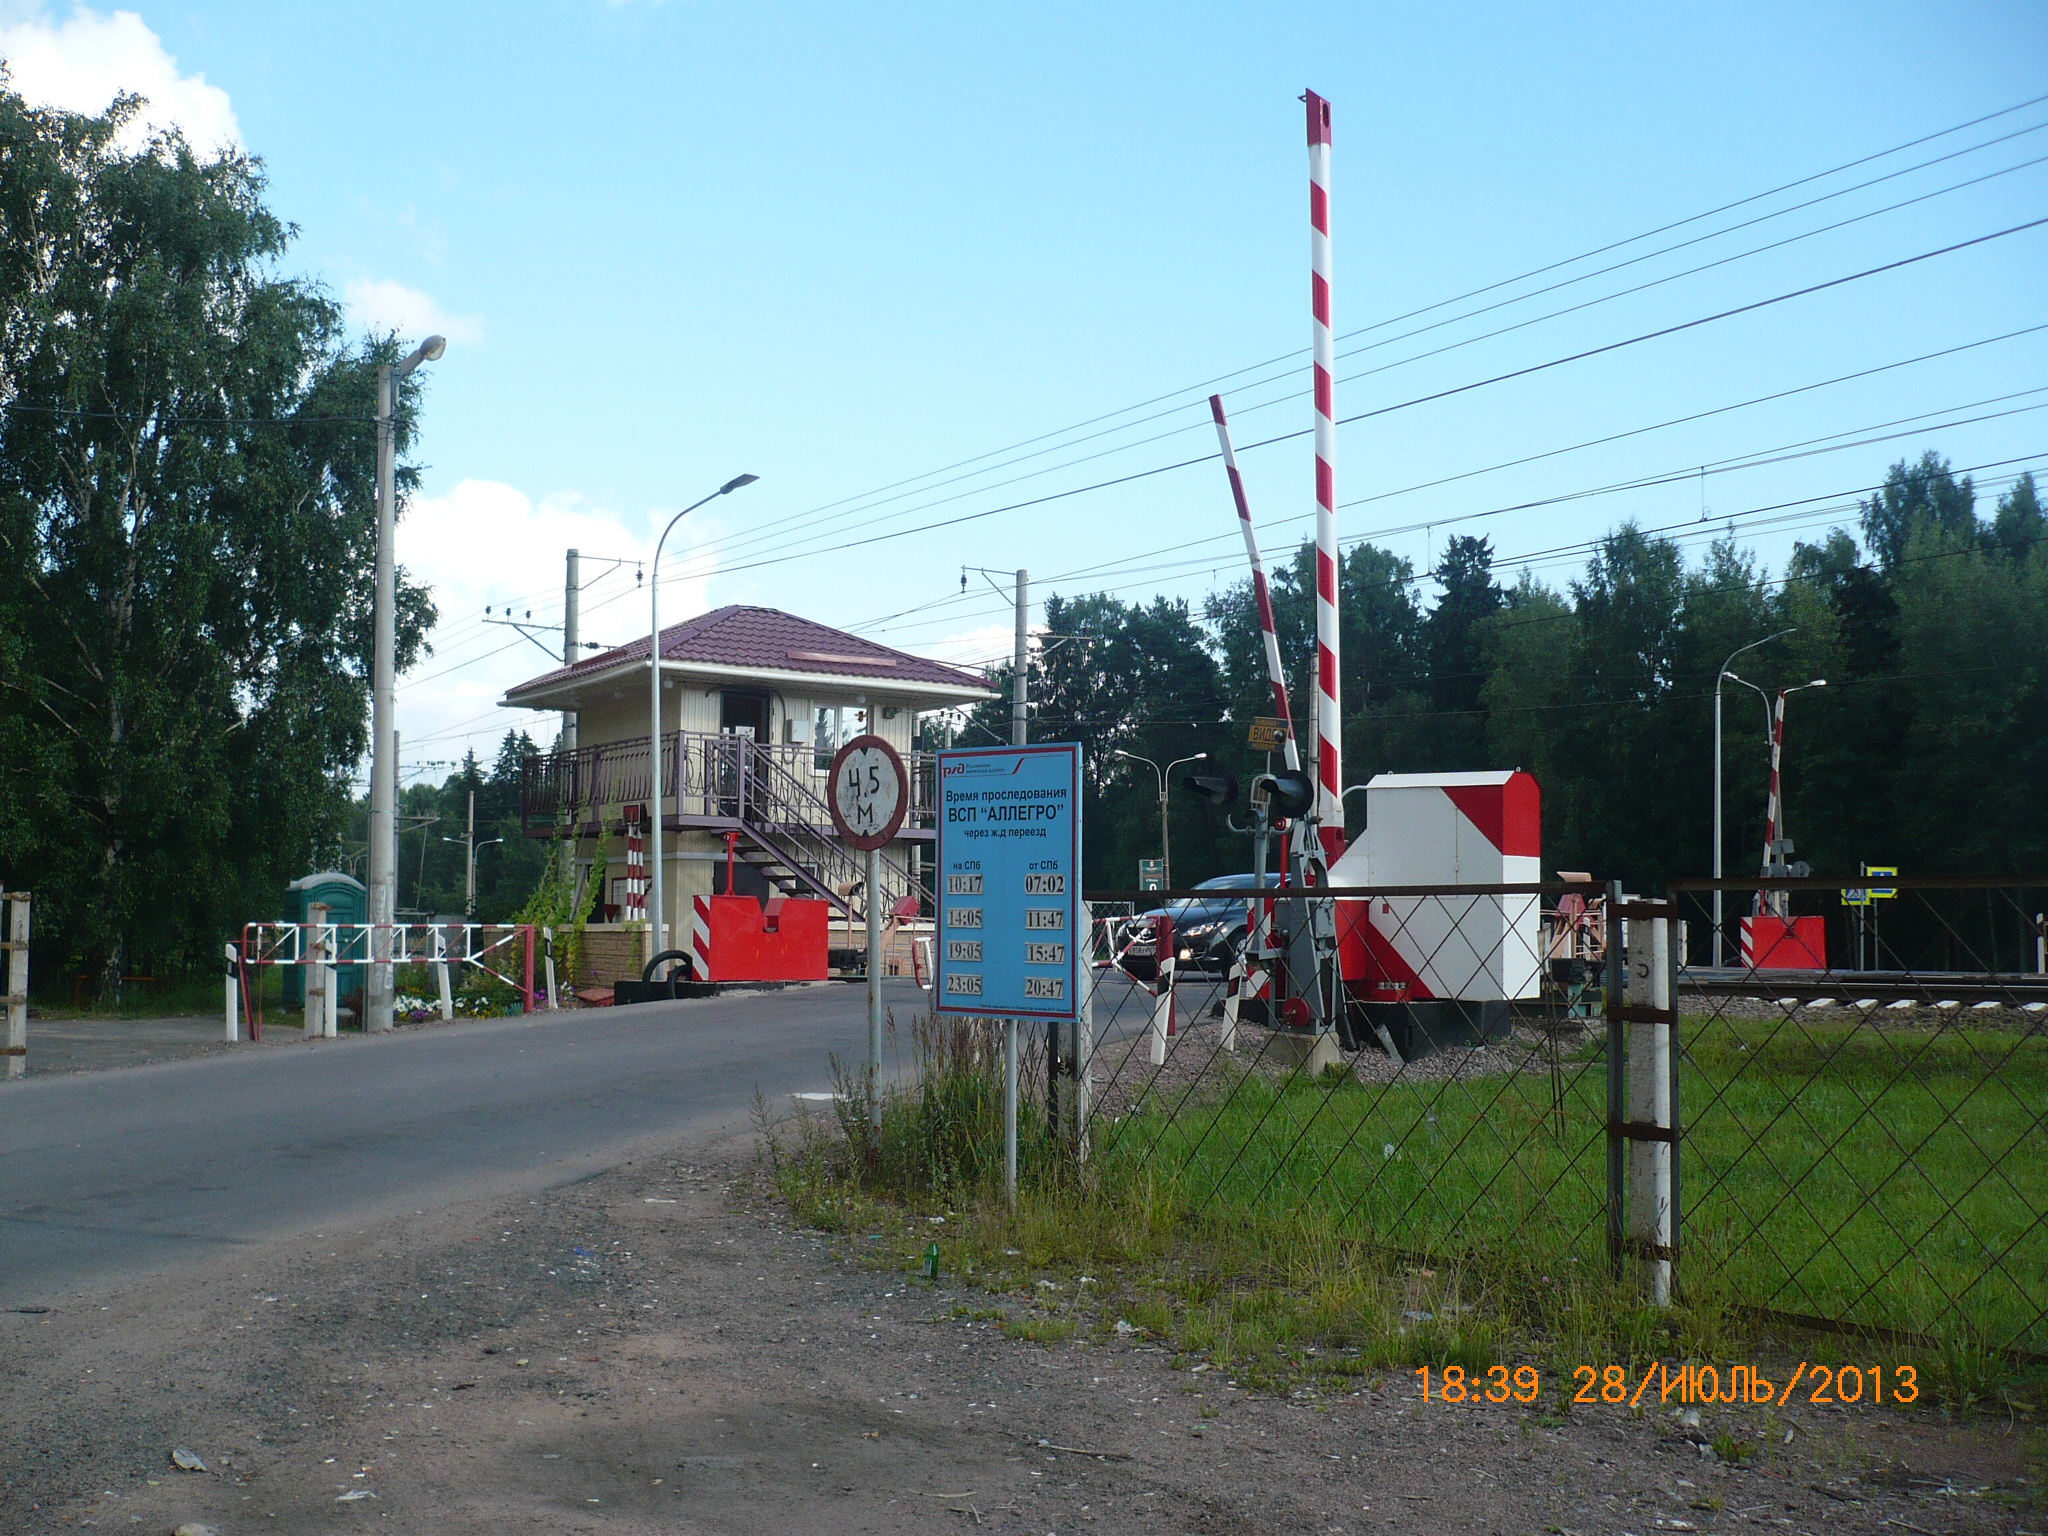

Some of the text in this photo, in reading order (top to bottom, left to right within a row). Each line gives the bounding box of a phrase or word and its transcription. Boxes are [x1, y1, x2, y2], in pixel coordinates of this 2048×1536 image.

[946, 789, 1067, 804] Время проследования
[948, 807, 977, 822] ВСП
[964, 828, 1047, 839] через ж.д переезд
[953, 861, 981, 870] на СПб
[1029, 860, 1058, 870] от СПб
[948, 876, 982, 893] 10:17
[1025, 875, 1065, 893] 07:02
[949, 910, 982, 926] 14:05
[1028, 912, 1063, 927] 11:47
[949, 943, 982, 959] 19:05
[1029, 945, 1065, 961] 15:47
[947, 976, 982, 993] 23:05
[1026, 979, 1063, 997] 20:47
